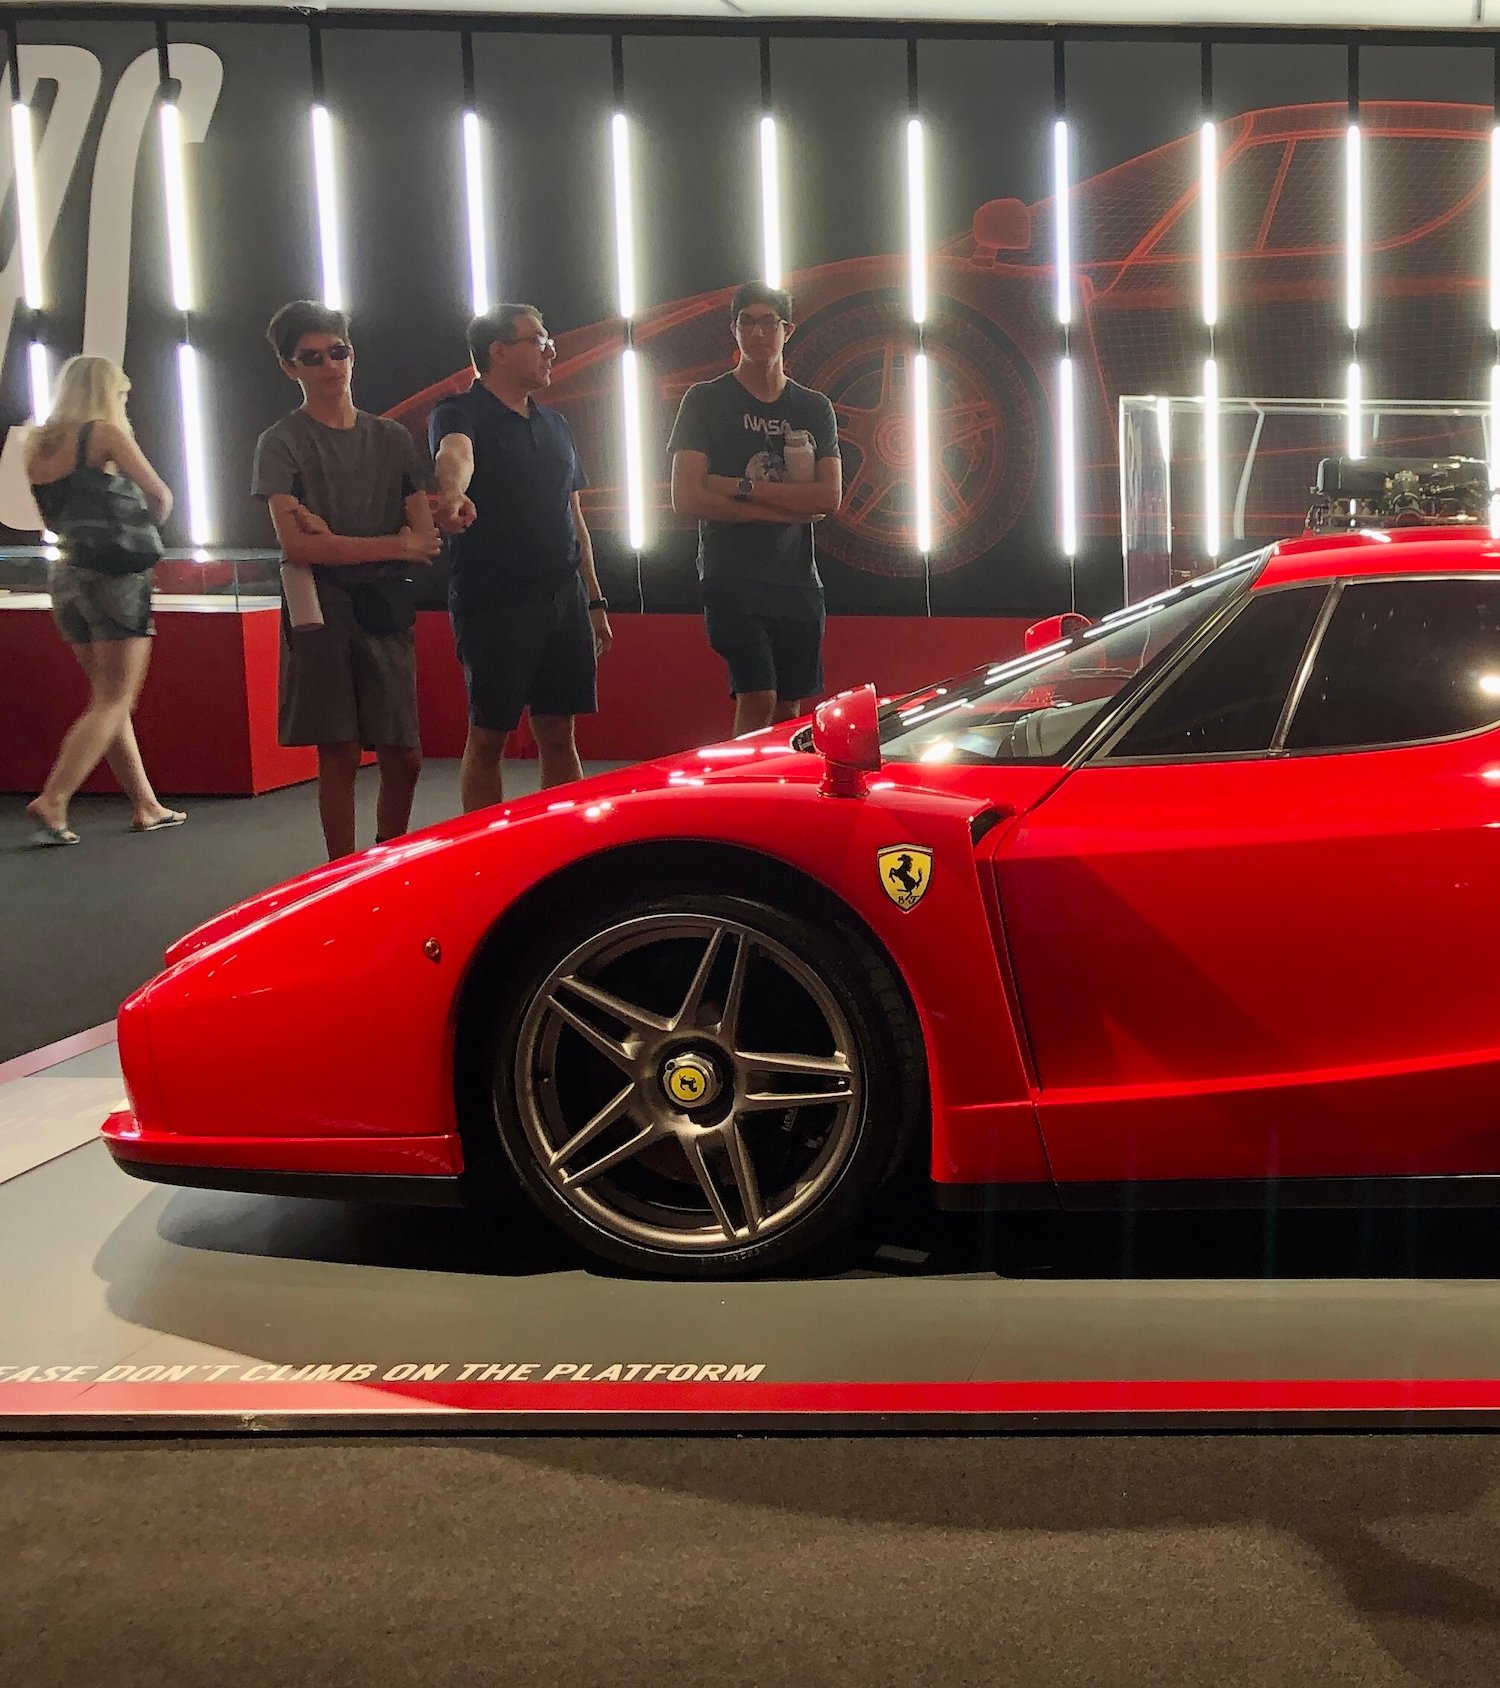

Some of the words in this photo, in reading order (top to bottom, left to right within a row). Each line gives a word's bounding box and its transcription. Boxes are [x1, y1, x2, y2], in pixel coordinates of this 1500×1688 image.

[743, 413, 792, 435] NASA
[95, 1364, 240, 1382] DON'T
[239, 1364, 378, 1381] CLIMB
[381, 1363, 450, 1382] ON
[455, 1363, 541, 1381] THE
[543, 1363, 767, 1382] PLATFORM
